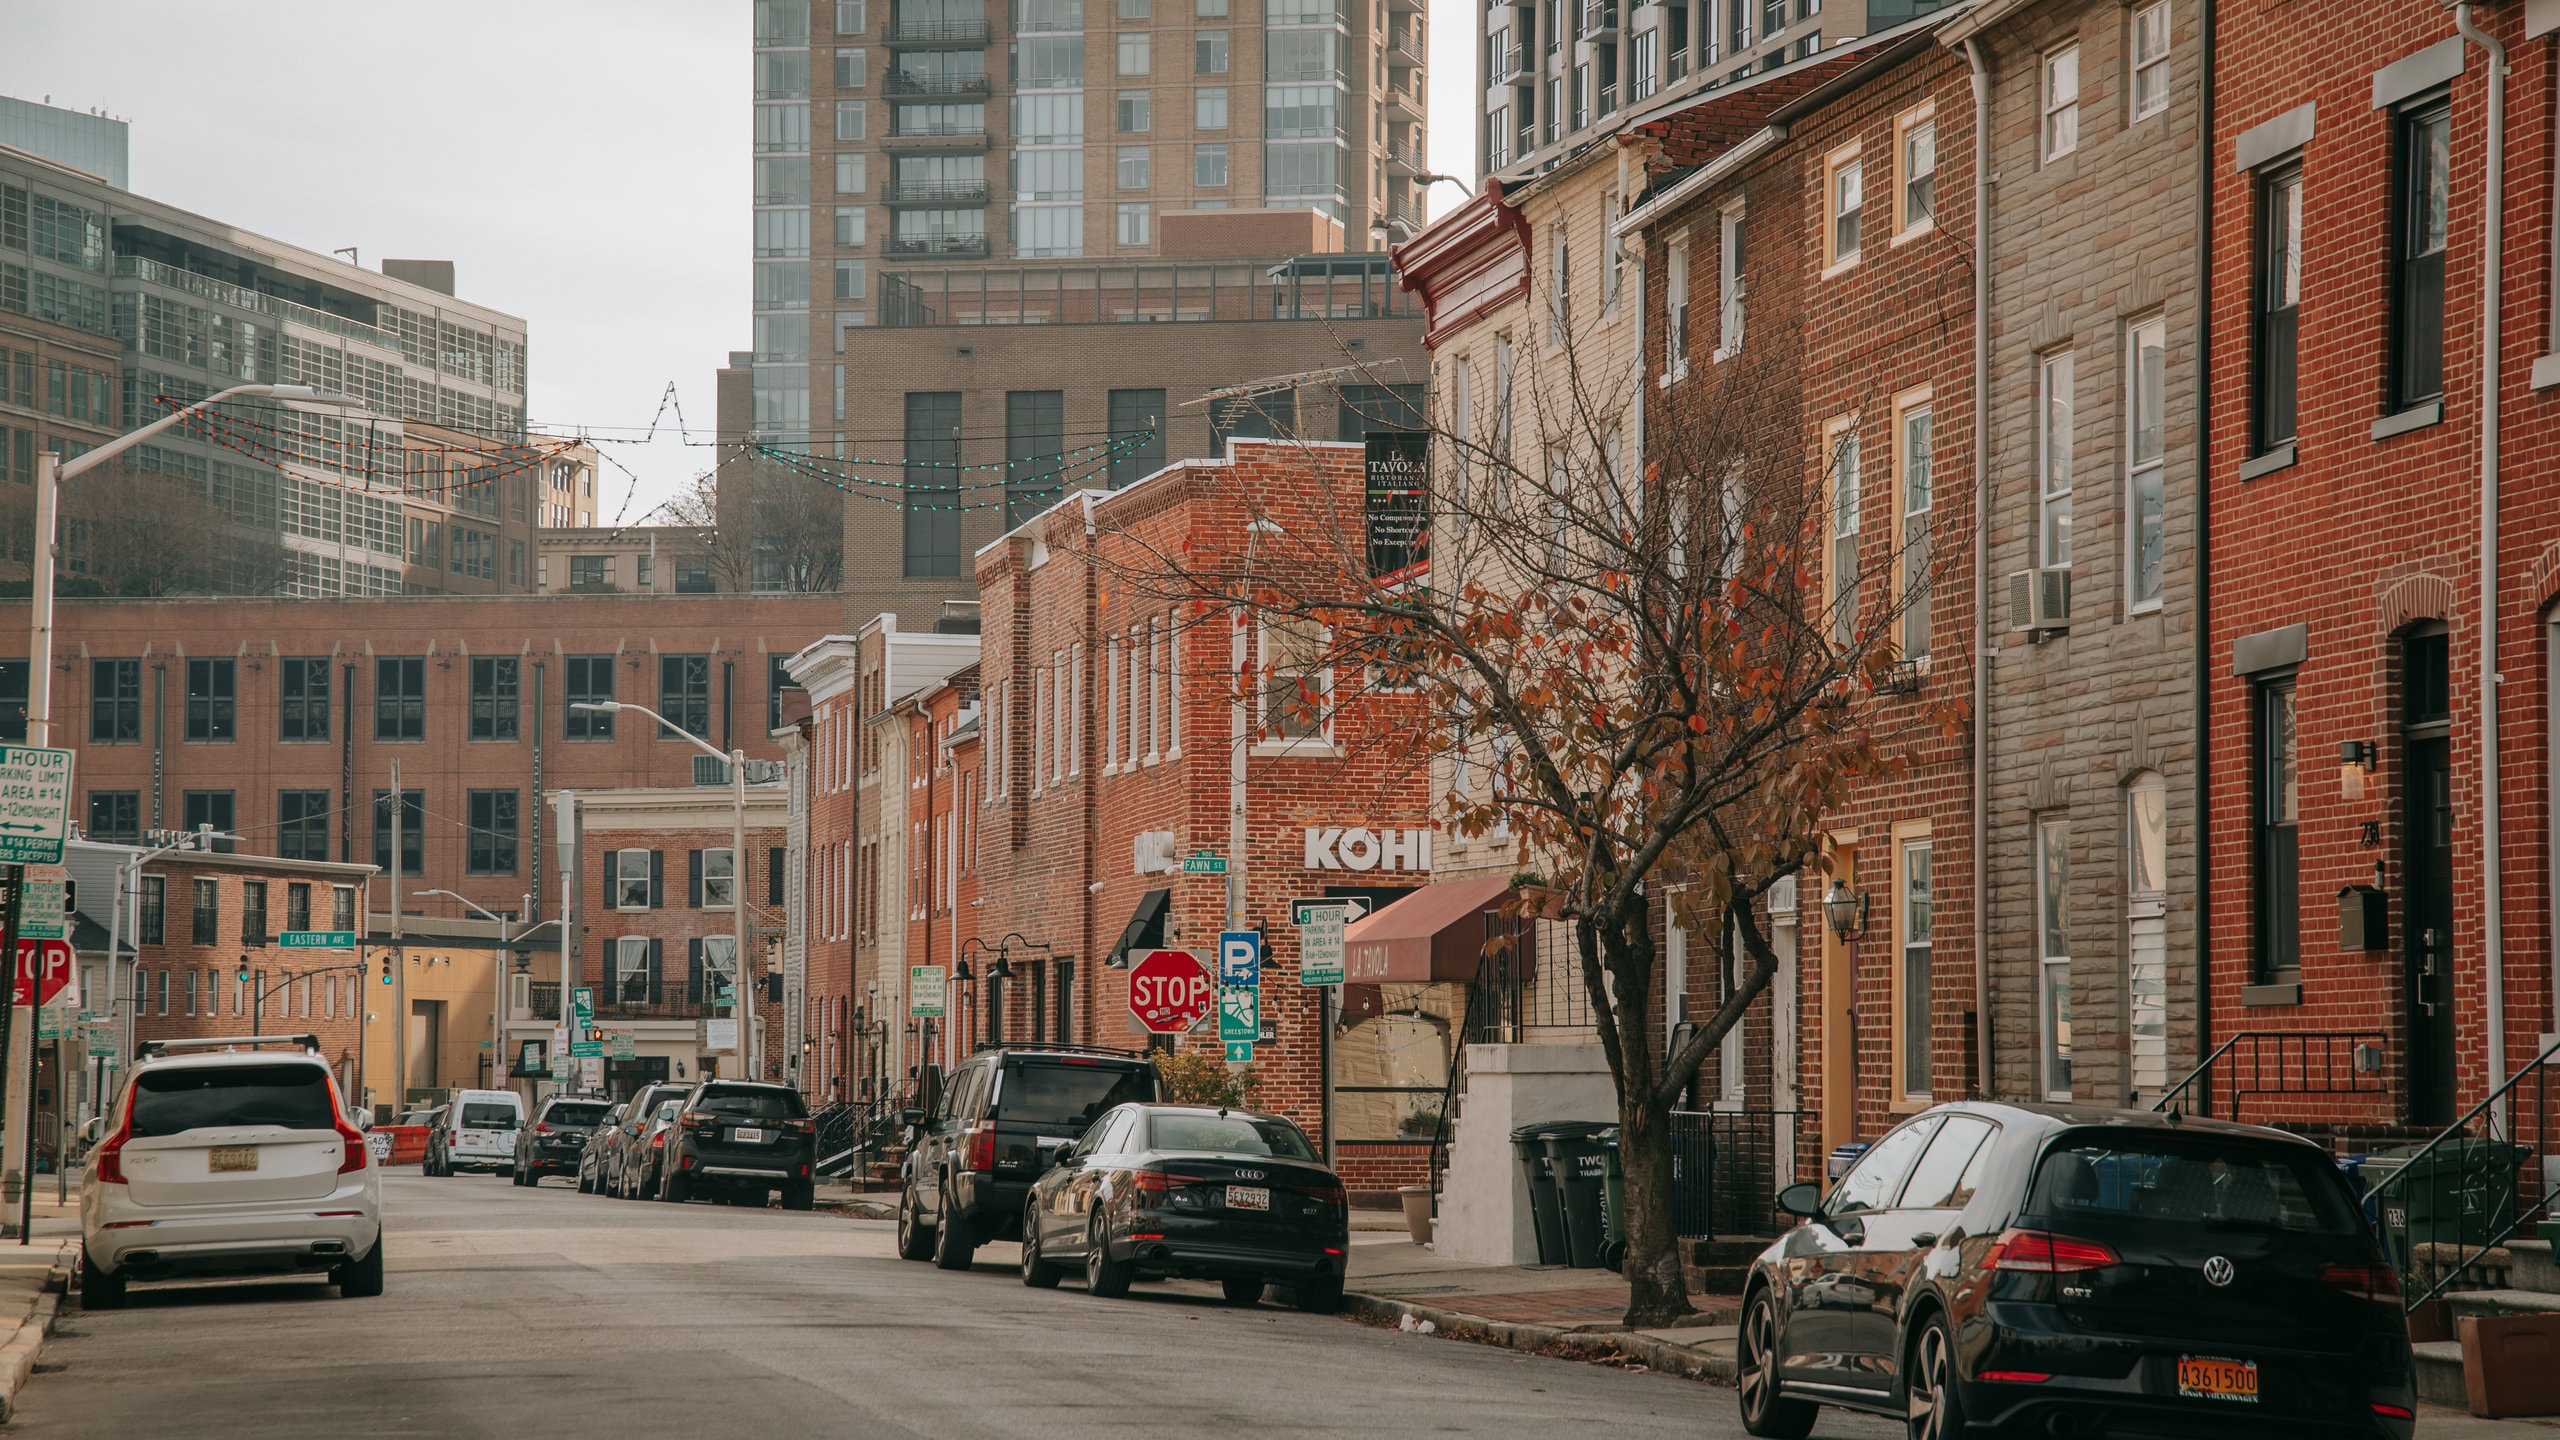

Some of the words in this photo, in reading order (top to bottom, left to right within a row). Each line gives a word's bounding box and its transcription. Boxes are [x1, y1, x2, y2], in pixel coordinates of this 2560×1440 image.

[1391, 451, 1404, 461] La
[11, 751, 63, 768] HOUR
[0, 767, 32, 782] RKING
[38, 770, 64, 784] LIMIT
[2, 784, 34, 800] AREA
[153, 750, 161, 830] URNITURE
[1185, 860, 1210, 870] FAWN
[34, 884, 60, 894] HOUR
[1304, 912, 1310, 922] 3
[1316, 910, 1340, 922] HOUR
[1304, 925, 1326, 934] PARKING
[1328, 924, 1340, 934] LIMIT
[290, 934, 326, 945] EASTERN
[1304, 938, 1310, 947] IN
[1312, 938, 1326, 946] AREA
[14, 949, 66, 980] TOP
[1224, 941, 1254, 977] P
[1352, 946, 1361, 977] LA
[1364, 945, 1388, 977] TAVOLA
[1134, 976, 1206, 1006] STOP
[1228, 1191, 1268, 1204] 5EX2932
[2063, 1286, 2092, 1298] GTI
[2182, 1364, 2255, 1390] A361500
[2206, 1392, 2258, 1402] VOLKSWAGEN
